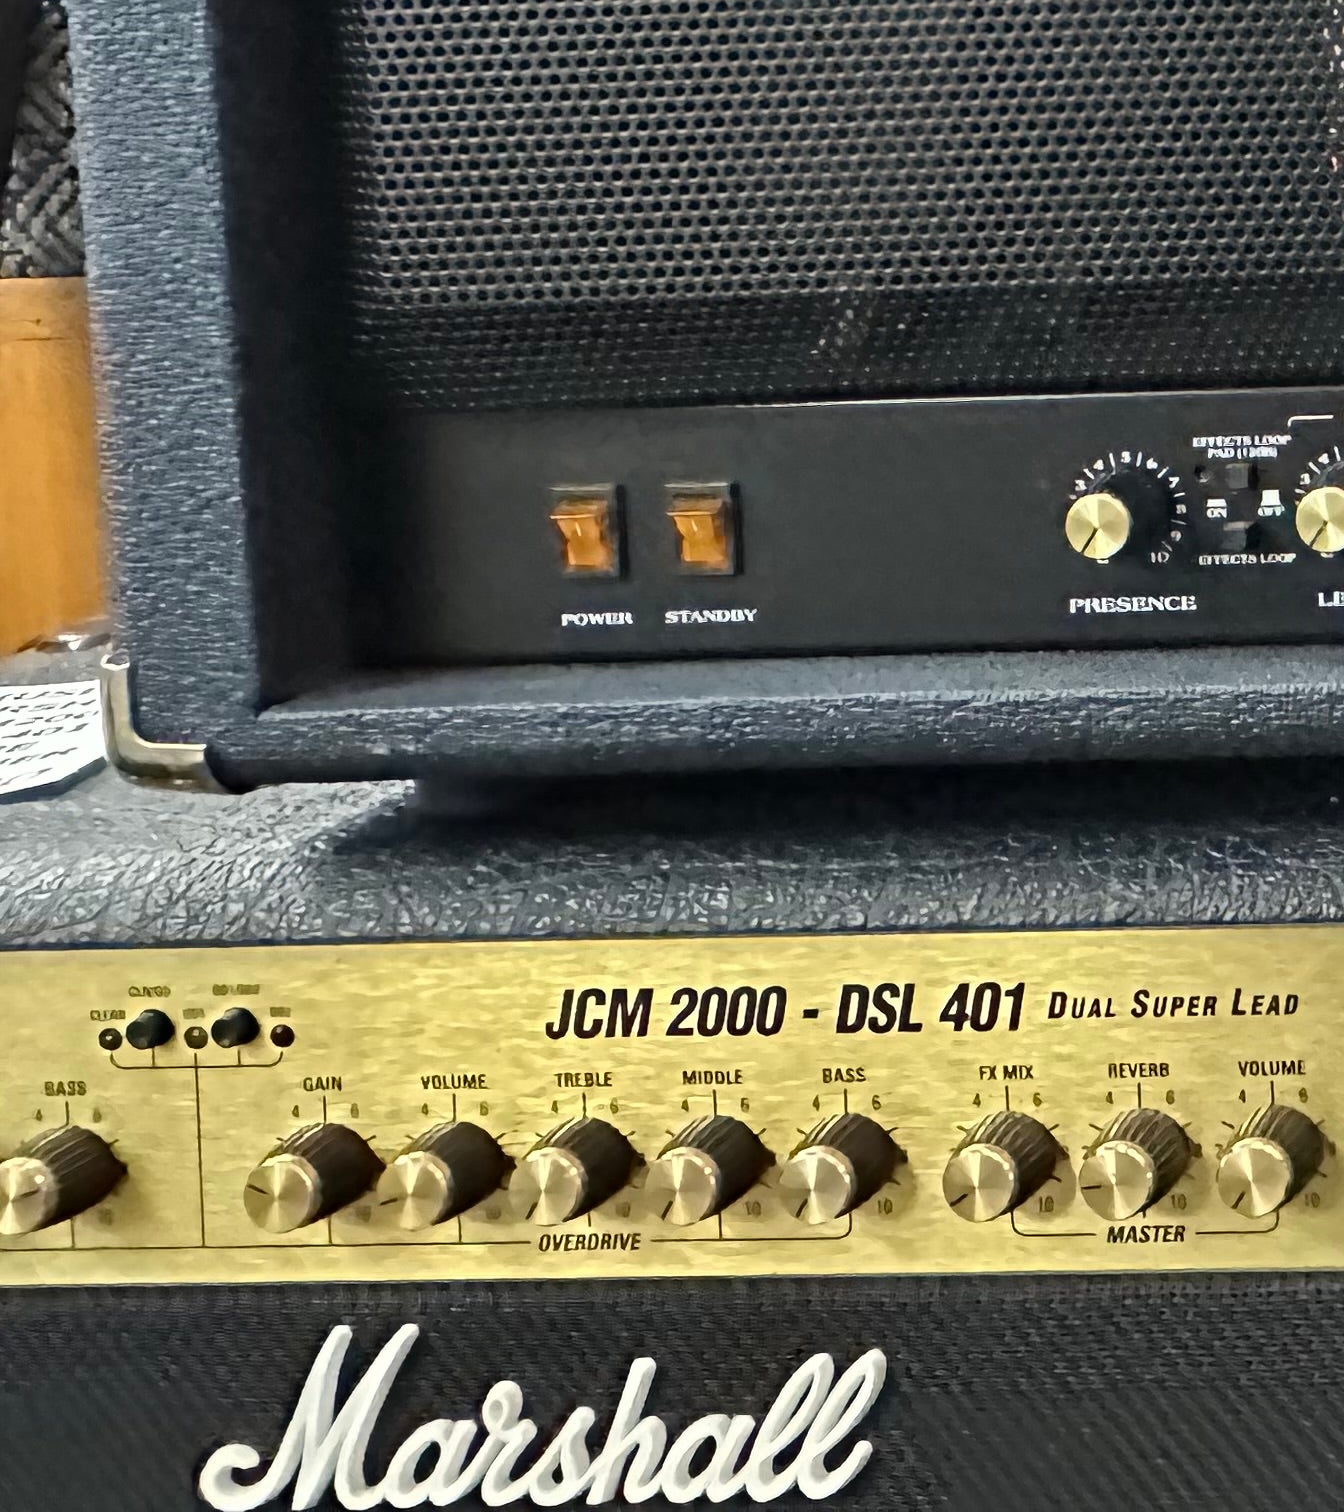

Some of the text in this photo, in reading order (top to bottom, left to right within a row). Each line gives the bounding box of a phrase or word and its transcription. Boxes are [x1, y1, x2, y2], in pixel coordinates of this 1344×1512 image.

[1069, 594, 1197, 614] PRESENCE
[561, 611, 634, 627] POWER
[664, 608, 758, 625] STANDBY
[545, 987, 655, 1040] JCM
[665, 985, 787, 1038] 2000
[835, 982, 923, 1035] DSL
[938, 981, 1026, 1033] 401
[1047, 990, 1117, 1019] DUAL
[1130, 988, 1218, 1018] SUPER
[1231, 987, 1300, 1017] LEAD
[821, 1067, 867, 1084] BASS
[978, 1064, 1035, 1081] FX MIX
[1107, 1062, 1170, 1078] REVERB
[1237, 1060, 1307, 1076] VOLUME
[302, 1075, 343, 1093] GAIN
[420, 1073, 488, 1091] VOLUME
[553, 1071, 614, 1088] TREBLE
[681, 1069, 744, 1086] MIDDLE
[44, 1080, 87, 1097] BASS
[551, 1100, 558, 1113] 4
[682, 1098, 689, 1111] 4
[973, 1093, 981, 1107] 4
[292, 1104, 299, 1118] 4
[813, 1095, 893, 1214] 4 6 10
[537, 1232, 642, 1252] OVERDRIVE
[1106, 1225, 1186, 1244] MASTER
[200, 1322, 887, 1512] Marshall
